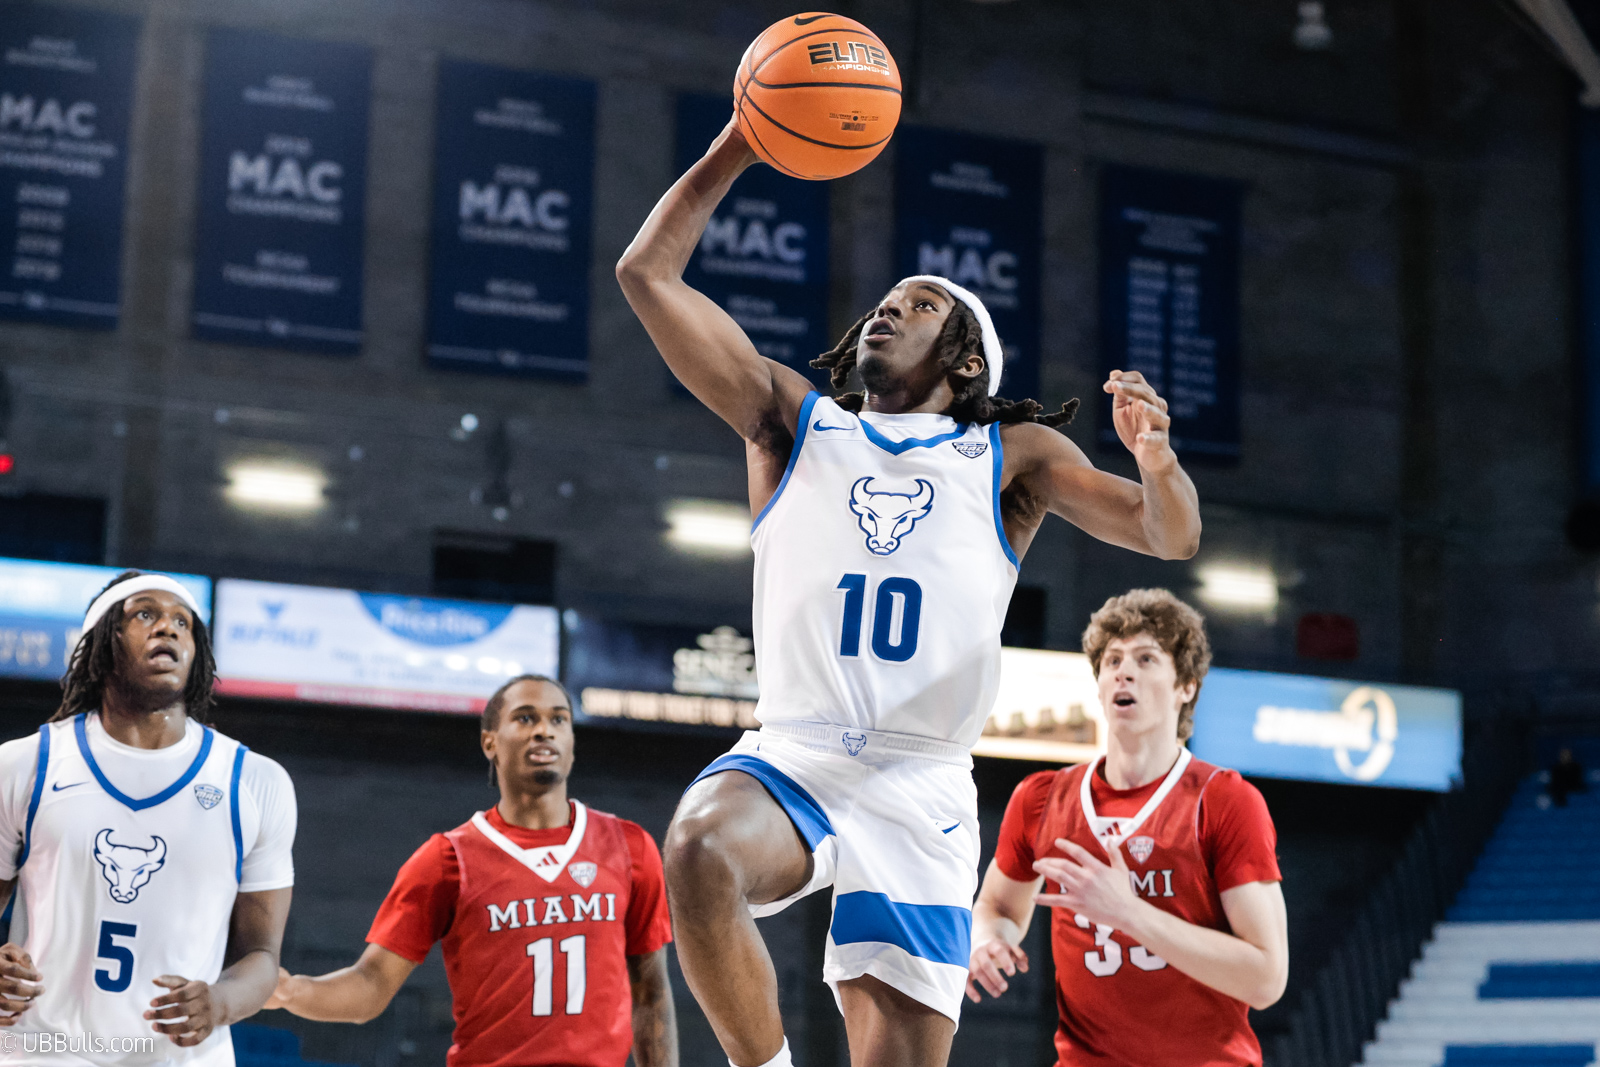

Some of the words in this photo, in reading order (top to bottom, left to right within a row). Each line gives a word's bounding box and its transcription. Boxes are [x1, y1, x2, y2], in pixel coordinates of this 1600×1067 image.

[807, 41, 889, 69] ELITE
[811, 63, 890, 76] AMPIONSHIP
[0, 93, 97, 138] MAC
[228, 151, 344, 202] MAC
[459, 180, 570, 231] MAC
[701, 215, 808, 264] MAC
[917, 241, 1019, 292] MAC
[835, 572, 924, 664] 10
[486, 892, 617, 932] MIAMI
[94, 919, 138, 994] 5
[526, 934, 587, 1017] 11
